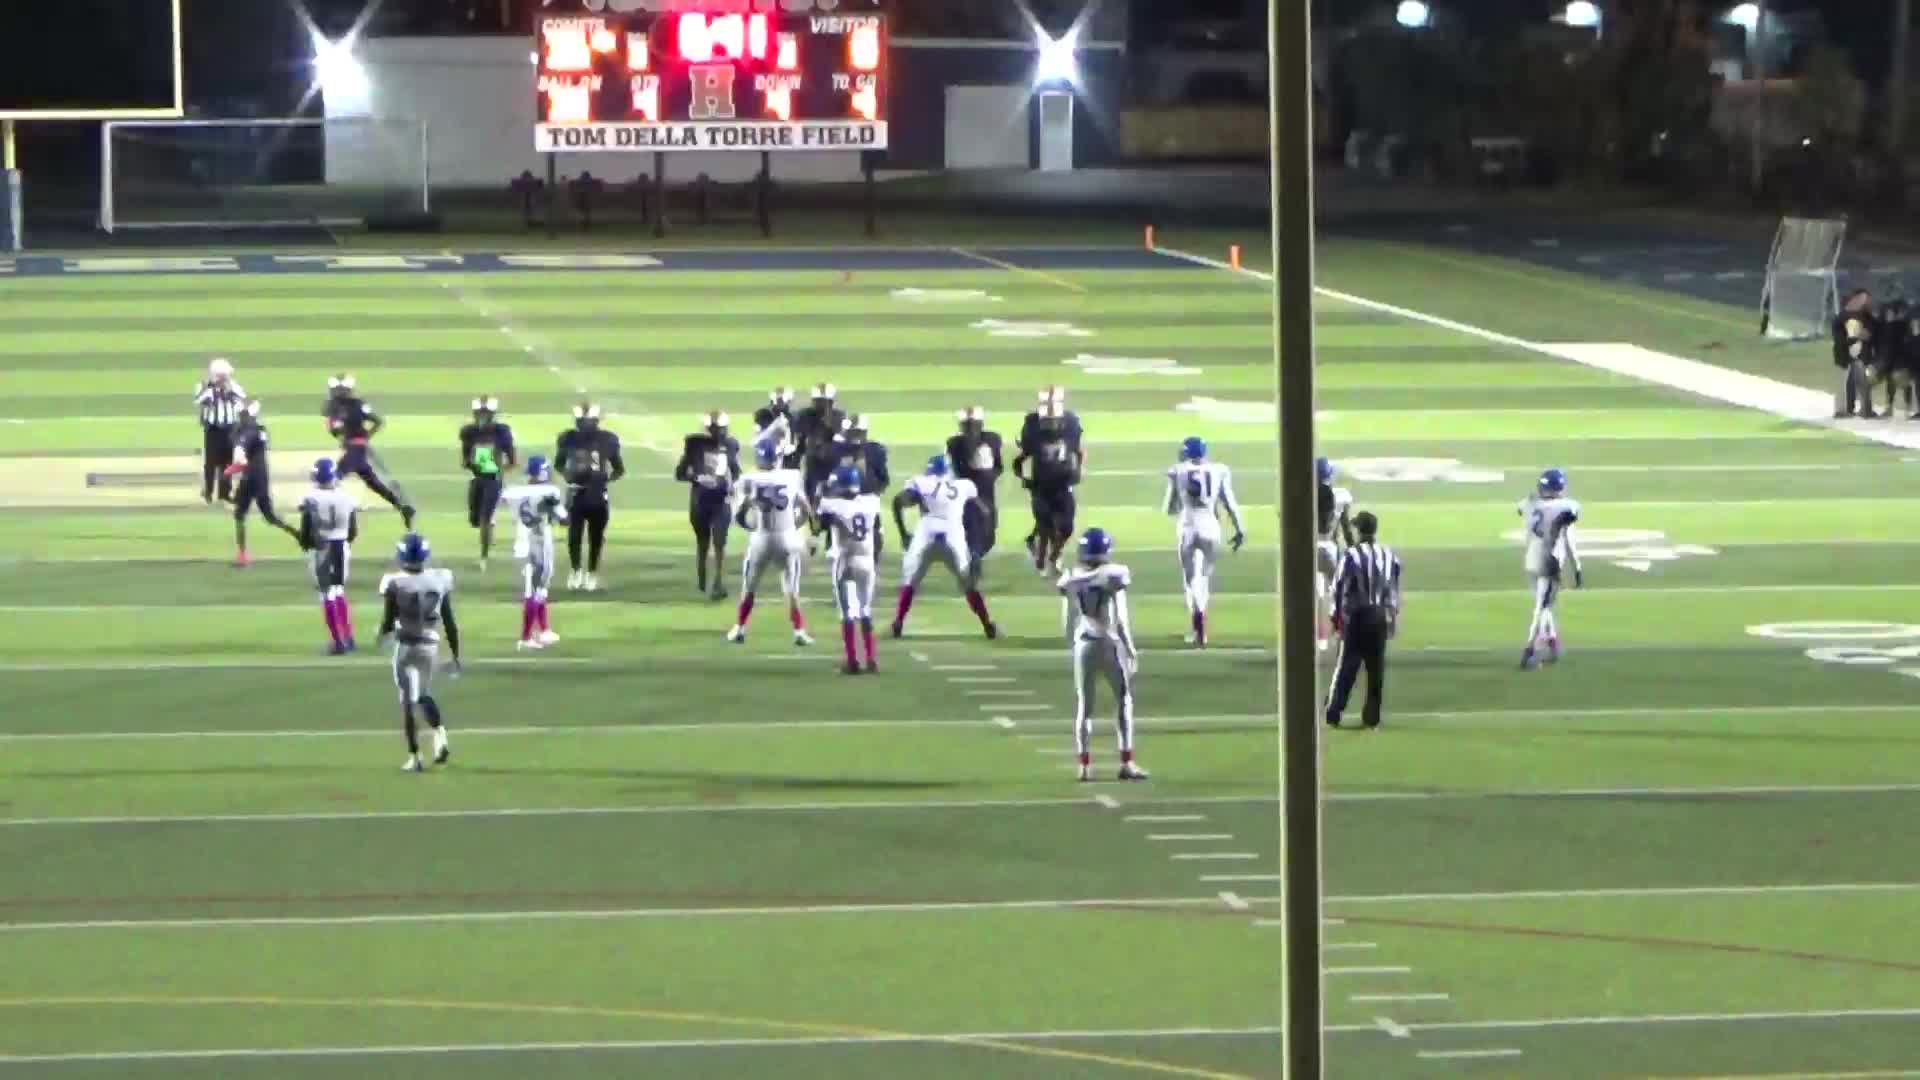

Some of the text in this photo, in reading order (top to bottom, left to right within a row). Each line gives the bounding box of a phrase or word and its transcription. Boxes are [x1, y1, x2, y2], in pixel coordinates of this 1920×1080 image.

[810, 15, 880, 34] VISITOR
[547, 126, 876, 147] TOM DELLA TORRE FIELD
[1187, 471, 1212, 498] 51
